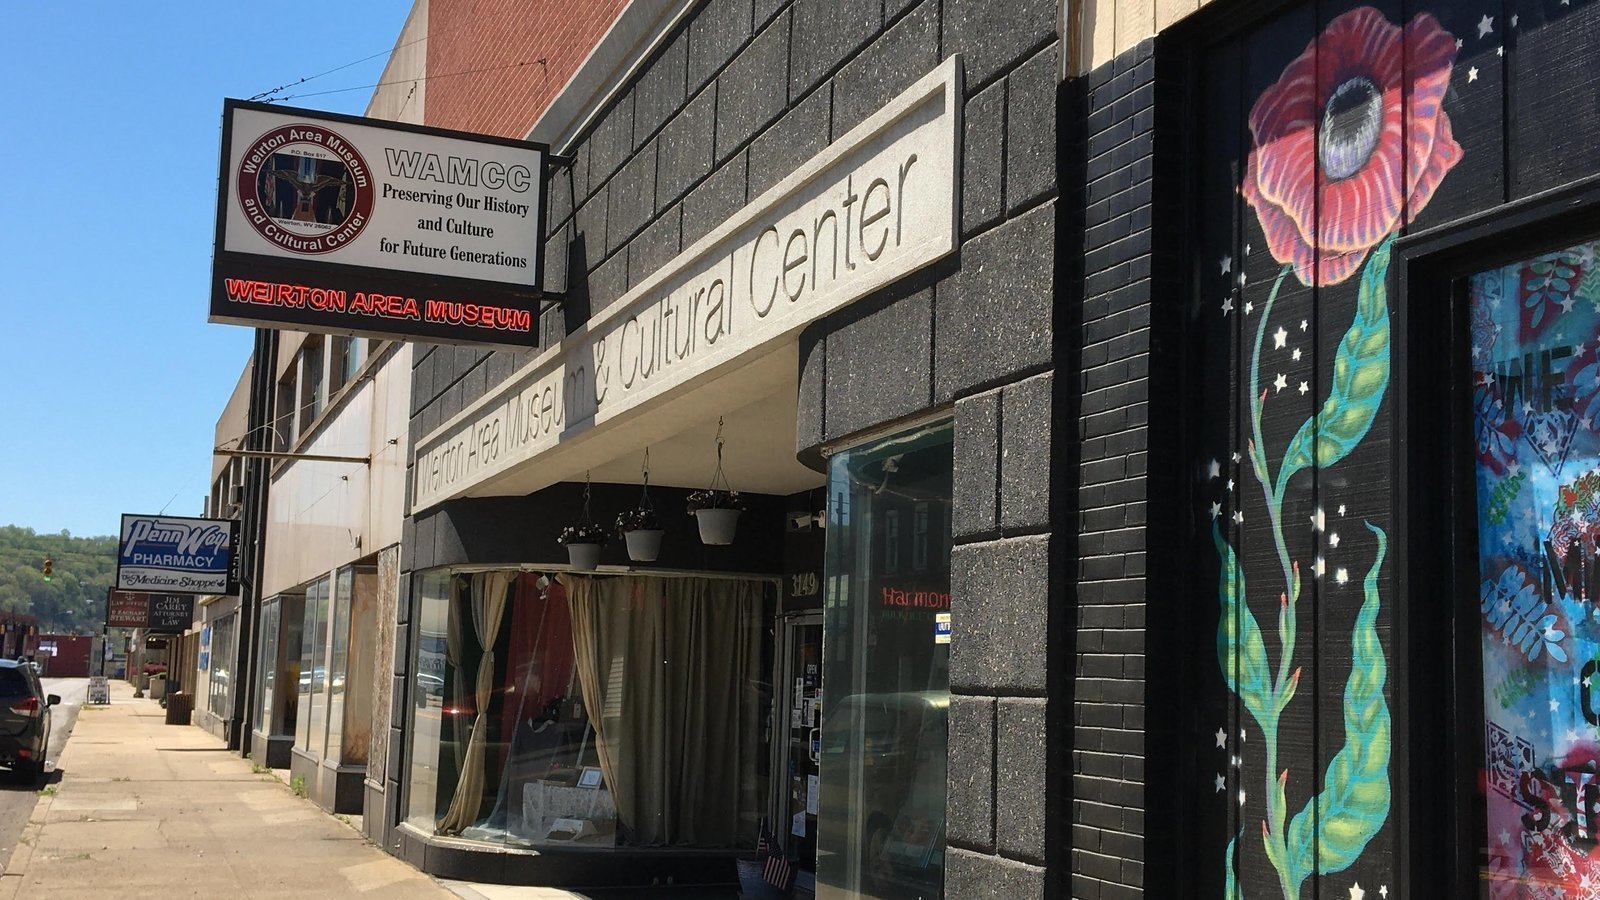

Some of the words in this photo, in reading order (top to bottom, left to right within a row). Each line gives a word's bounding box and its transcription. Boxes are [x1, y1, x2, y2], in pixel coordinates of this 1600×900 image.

[243, 133, 286, 174] Weirton
[289, 128, 322, 142] Area
[326, 135, 368, 188] Museum
[384, 147, 531, 193] WAMCC
[382, 182, 453, 209] Preserving
[456, 192, 481, 210] Our
[484, 195, 529, 218] History
[244, 198, 266, 225] and
[264, 224, 322, 250] Cultural
[326, 212, 365, 247] Center
[417, 217, 443, 232] and
[446, 218, 494, 239] Culture
[379, 237, 400, 254] for
[403, 240, 447, 259] Future
[450, 245, 527, 268] Generations
[224, 277, 347, 313] WEIRTON
[349, 291, 421, 321] AREA
[425, 298, 531, 332] MUSEUM
[421, 440, 464, 495] Weirton
[466, 418, 500, 473] Area
[504, 365, 585, 453] Museum
[594, 338, 610, 406] &
[618, 252, 735, 389] Cultural
[749, 153, 918, 318] Center
[123, 520, 184, 557] Penn
[176, 522, 228, 556] Way
[132, 553, 215, 568] PHARMACY
[127, 574, 179, 586] Medicine
[178, 576, 217, 589] Shoppe
[790, 572, 818, 597] 3149
[155, 602, 188, 611] CAREY
[164, 596, 180, 605] JIM
[882, 586, 952, 609] Harmon
[110, 614, 147, 622] STEWART
[153, 610, 189, 618] ATTORNEY
